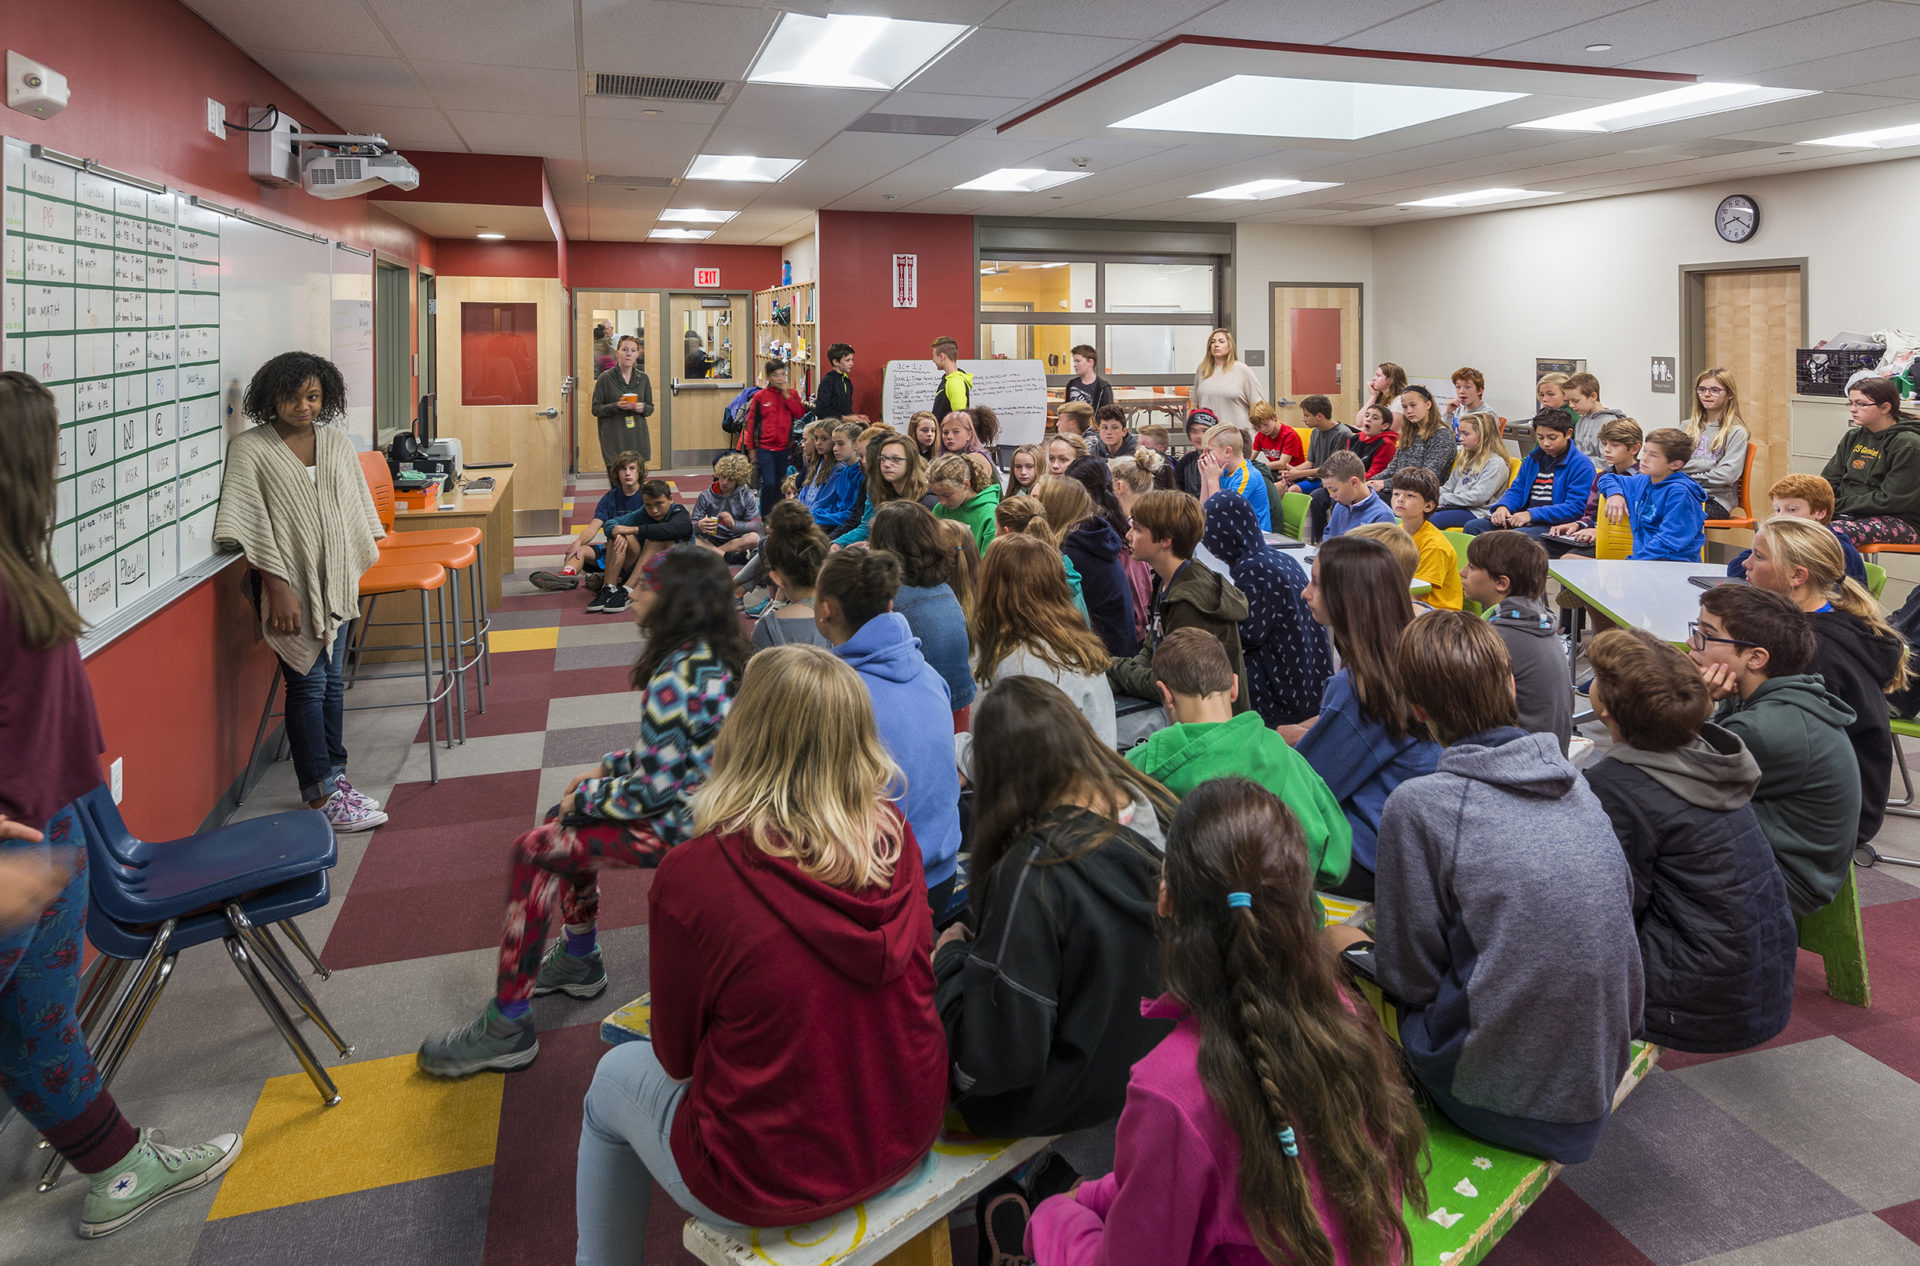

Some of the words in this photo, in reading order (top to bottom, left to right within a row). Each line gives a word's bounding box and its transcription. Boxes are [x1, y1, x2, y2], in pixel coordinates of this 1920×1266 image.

[31, 169, 55, 189] Monday
[11, 249, 16, 263] 2
[698, 270, 717, 284] EXIT
[41, 302, 60, 317] MATH
[87, 428, 98, 457] U
[123, 419, 135, 451] N
[154, 412, 163, 437] C
